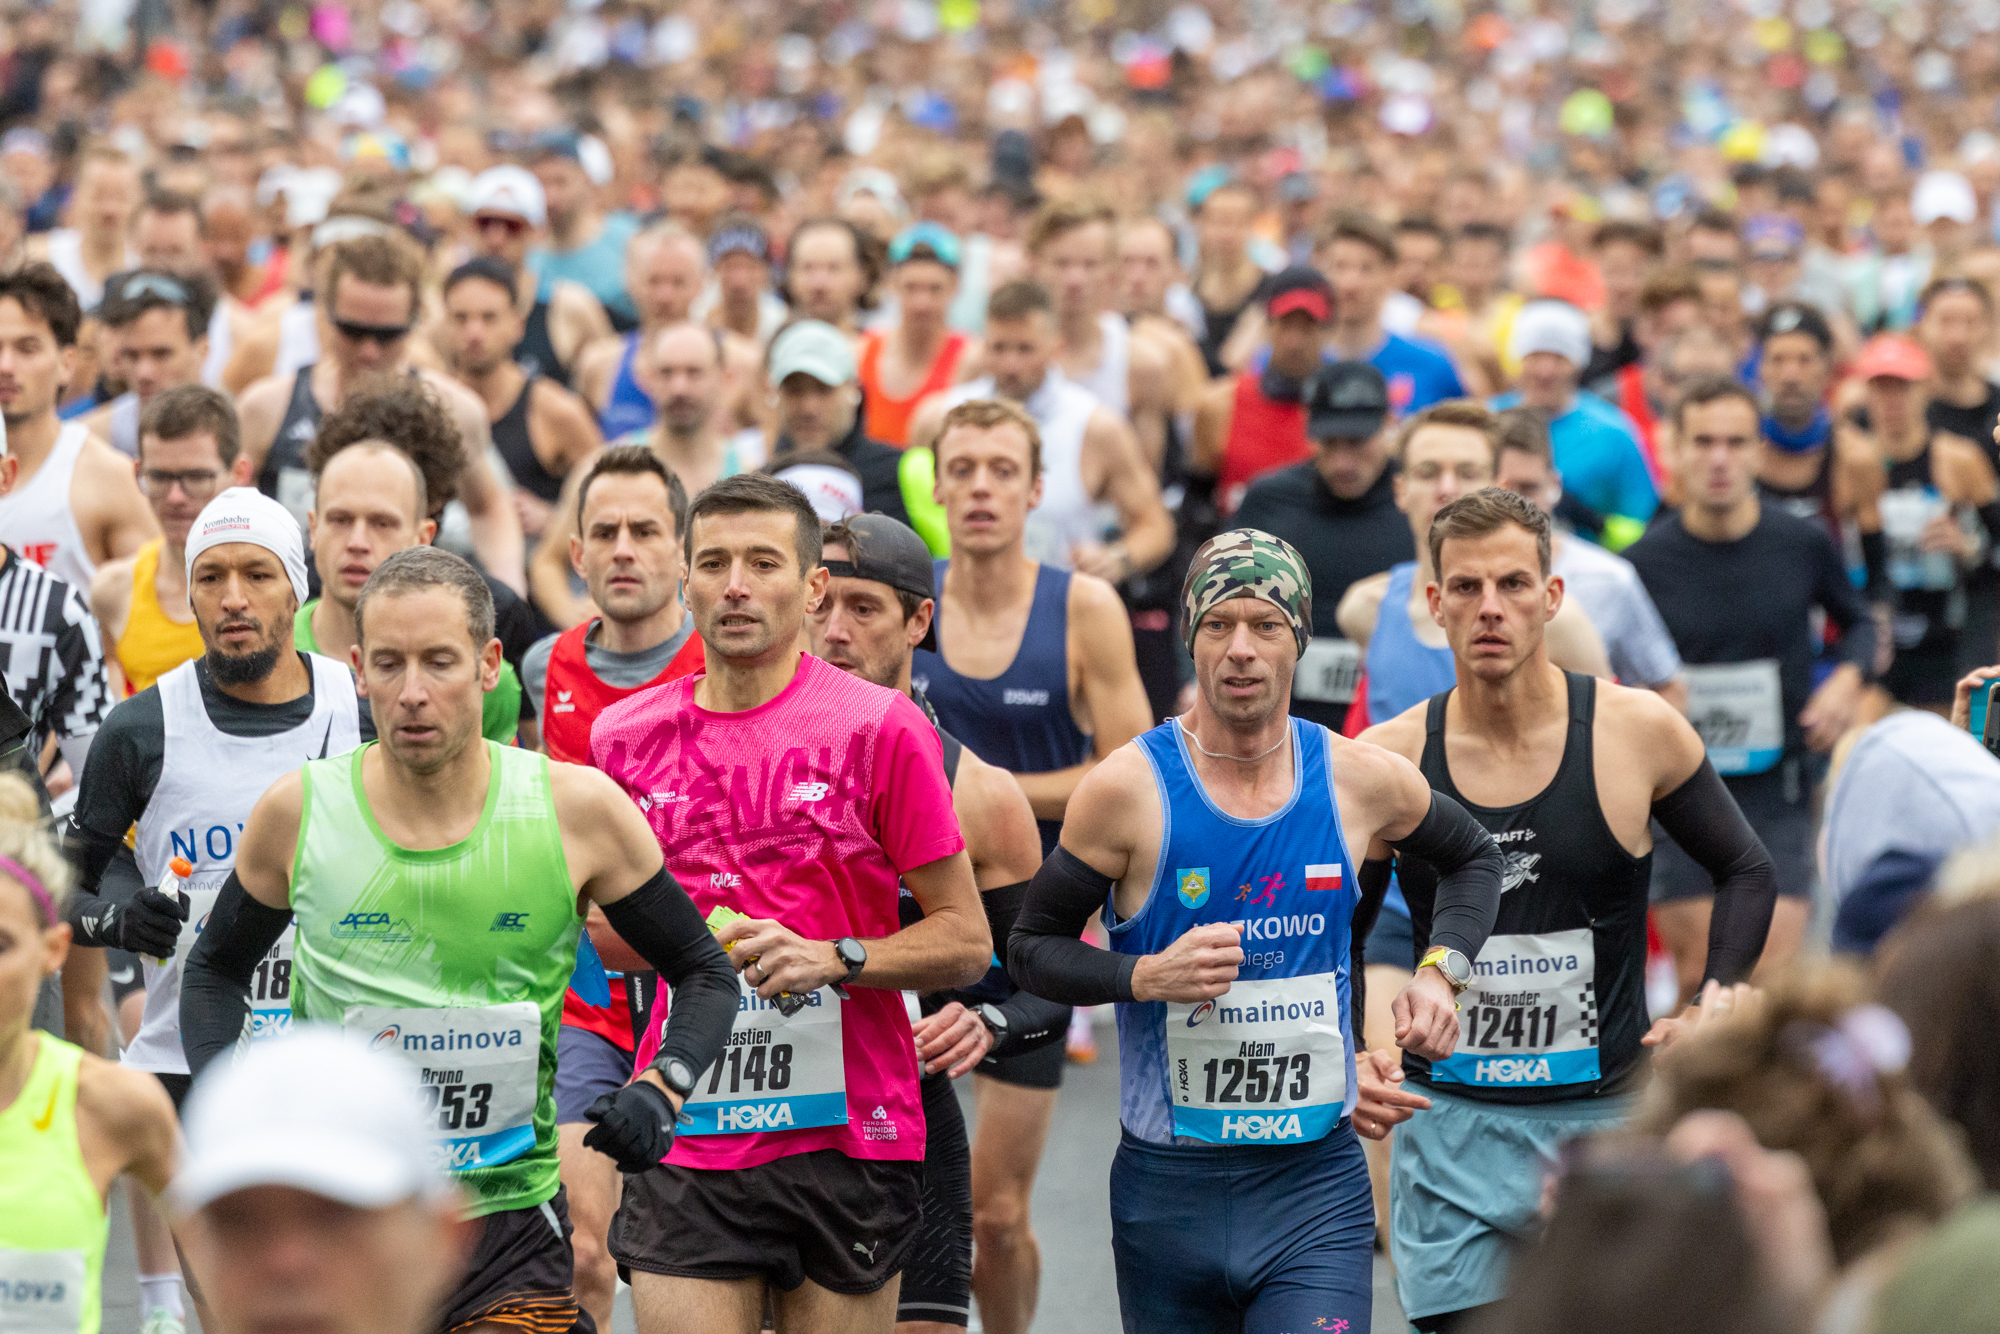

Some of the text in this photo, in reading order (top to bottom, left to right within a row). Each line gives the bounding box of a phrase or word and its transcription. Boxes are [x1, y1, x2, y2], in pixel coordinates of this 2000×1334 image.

[170, 823, 244, 864] NO
[1491, 830, 1525, 843] RAFT
[710, 872, 742, 888] RACE
[339, 912, 390, 930] ACCA
[1193, 913, 1325, 941] KOWO
[1474, 953, 1578, 977] mainova
[737, 988, 822, 1013] aina
[1478, 990, 1541, 1007] Alexander
[1219, 999, 1326, 1024] mainova
[253, 1013, 296, 1038] OKA
[1466, 1004, 1558, 1049] 12411
[403, 1028, 522, 1051] mainova
[1238, 1041, 1275, 1058] Adam
[420, 1067, 464, 1085] Bruno
[1178, 1058, 1189, 1091] HOKA
[1203, 1053, 1311, 1104] 12573
[1474, 1058, 1553, 1083] HOKA
[716, 1102, 795, 1131] HOKA
[1221, 1113, 1303, 1140] HOKA
